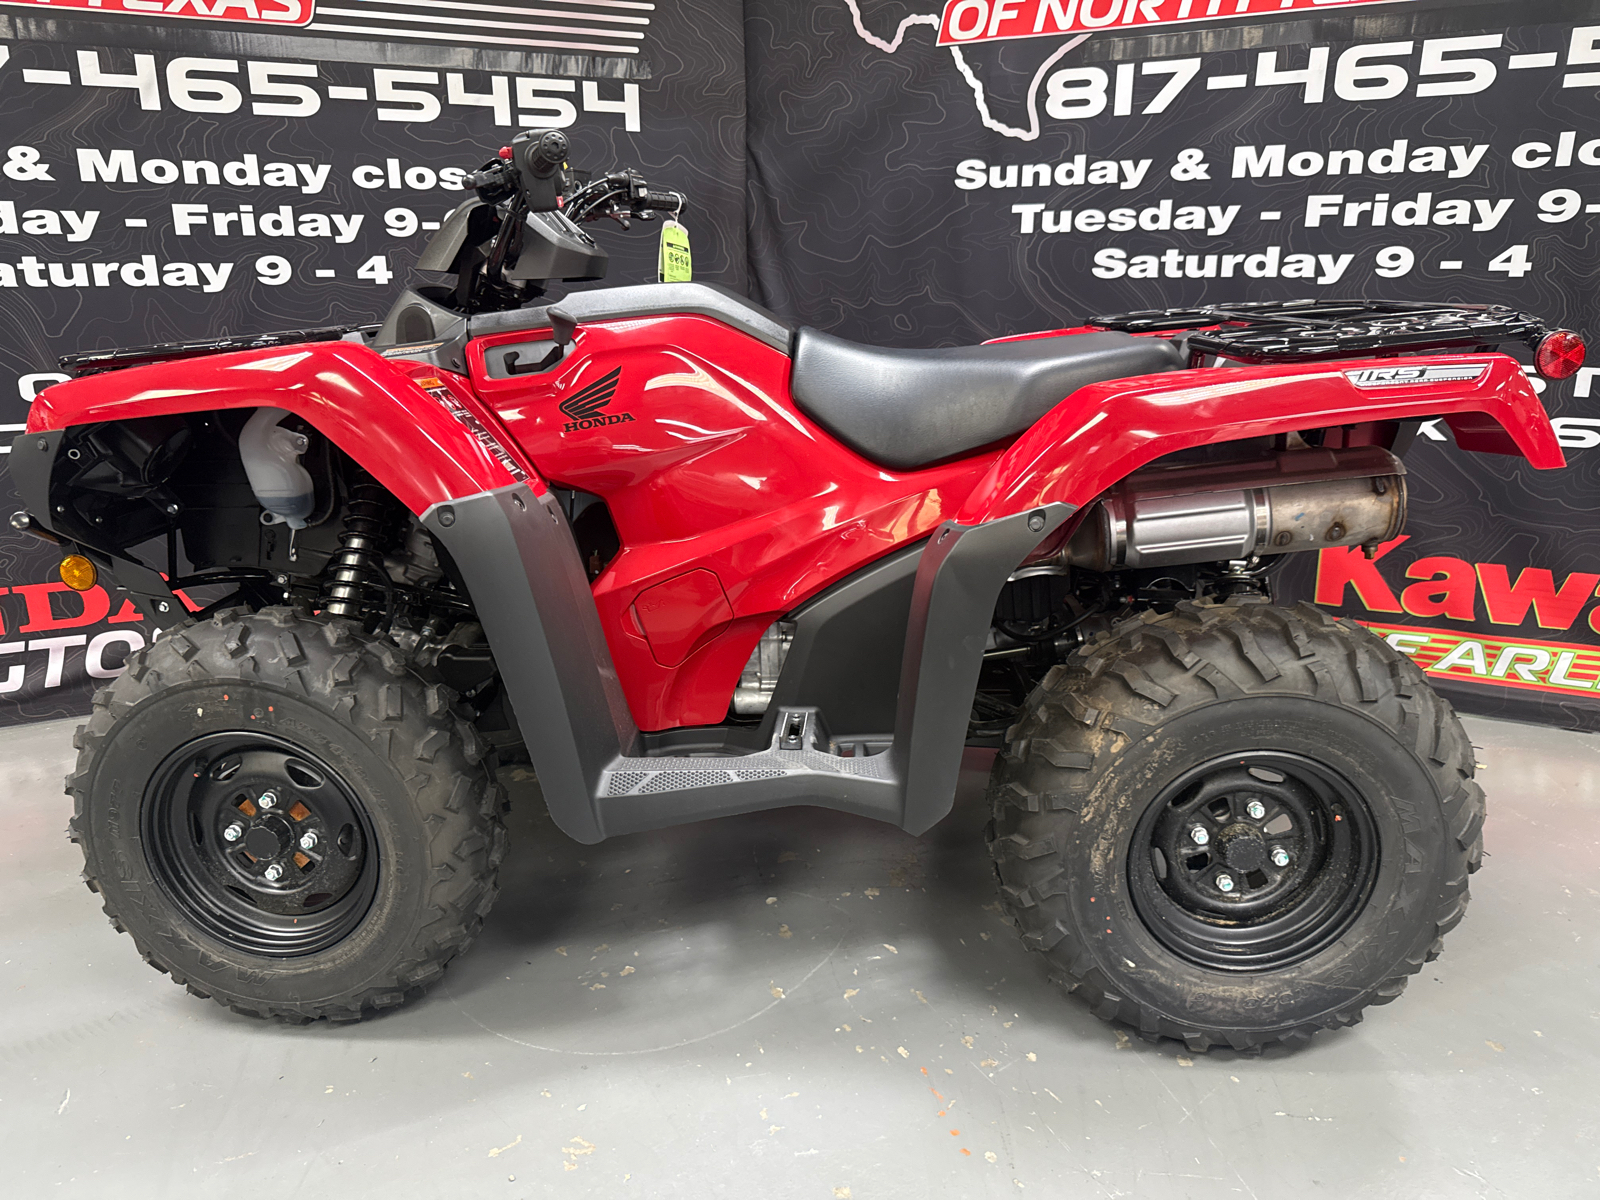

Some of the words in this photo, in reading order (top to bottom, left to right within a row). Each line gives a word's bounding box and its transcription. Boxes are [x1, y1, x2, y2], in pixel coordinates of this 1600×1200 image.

[948, 0, 1024, 39] OF
[0, 45, 641, 144] -465-5454
[2, 145, 56, 181] &
[76, 147, 332, 194] Monday
[954, 153, 1153, 190] Sunday
[1169, 147, 1212, 182] &
[1231, 138, 1490, 179] Monday
[124, 218, 148, 228] -
[172, 203, 365, 244] Friday
[383, 207, 457, 238] 9-
[1011, 198, 1242, 235] Tuesday
[1259, 210, 1282, 221] -
[1304, 191, 1515, 232] Friday
[254, 254, 293, 286] 9
[315, 269, 336, 278] -
[356, 255, 394, 284] 4
[1091, 245, 1355, 285] Saturday
[1374, 245, 1415, 278] 9
[1439, 260, 1463, 270] -
[1487, 244, 1533, 278] 4
[1359, 367, 1426, 381] IRS
[563, 412, 636, 432] HONDA
[1314, 534, 1600, 634] Kaw
